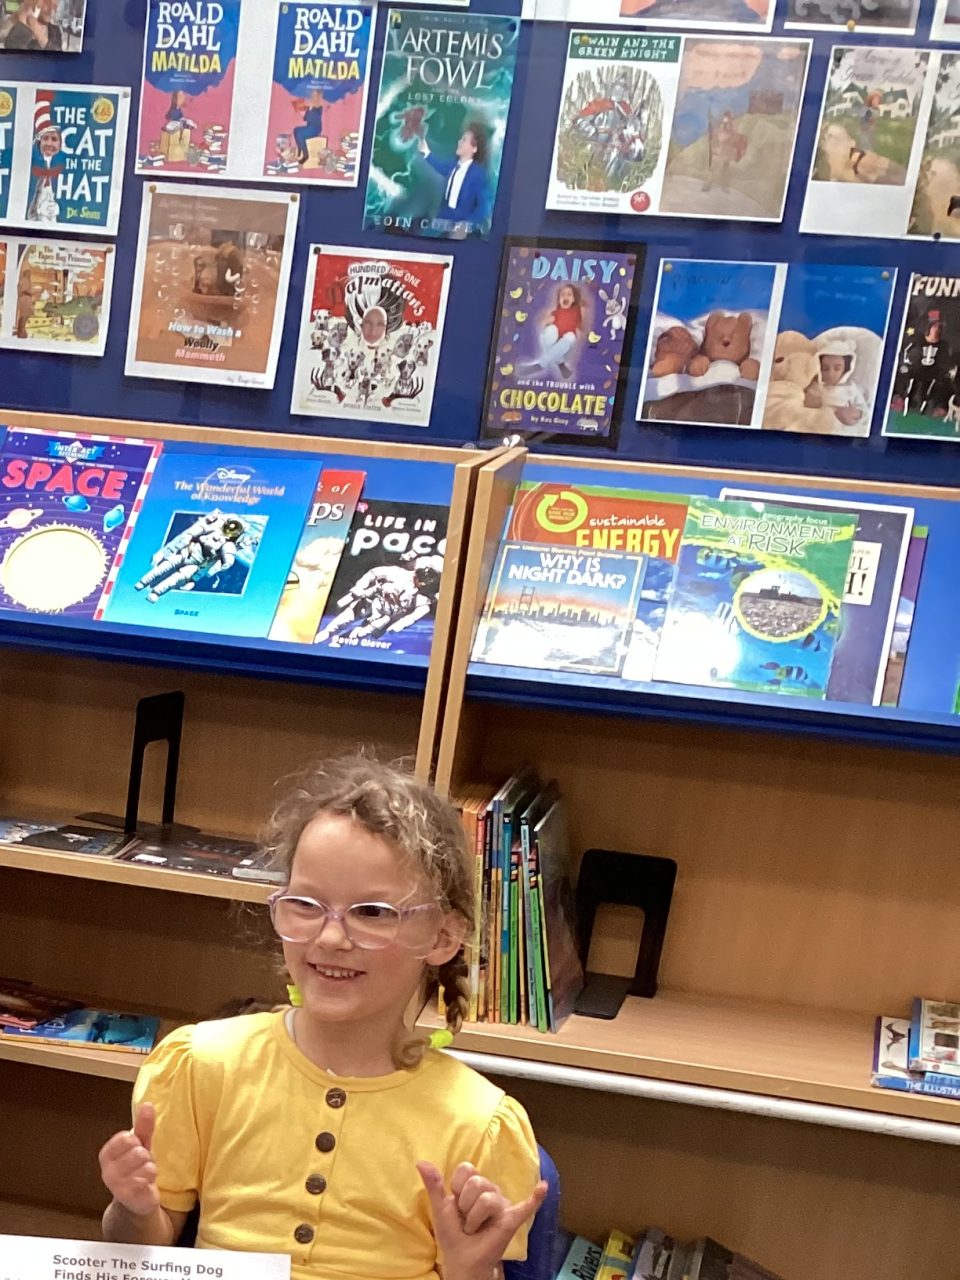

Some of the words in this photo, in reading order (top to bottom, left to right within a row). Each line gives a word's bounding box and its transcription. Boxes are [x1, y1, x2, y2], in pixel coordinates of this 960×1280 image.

[157, 1, 224, 25] ROALD
[295, 7, 363, 31] ROALD
[155, 24, 221, 51] DAHL
[293, 31, 360, 58] DAHL
[401, 27, 505, 59] ARTEMIS
[573, 35, 620, 47] GWAIN
[624, 38, 649, 48] AND
[652, 39, 676, 50] THE
[151, 51, 221, 73] MATILDA
[578, 46, 617, 58] GREEN
[621, 49, 668, 59] KNIGHT
[288, 57, 360, 80] MATILDA
[406, 56, 494, 89] FOWL
[54, 106, 86, 124] THE
[62, 127, 113, 157] CAT
[65, 158, 77, 170] IN
[81, 159, 102, 171] THE
[57, 173, 109, 202] HAT
[66, 206, 78, 219] Dr.
[80, 207, 101, 220] Seuss
[349, 264, 387, 274] HUNDRED
[389, 268, 404, 278] AND
[404, 273, 421, 288] ONE
[532, 255, 618, 283] DAISY
[168, 321, 192, 334] How
[194, 324, 205, 335] to
[207, 324, 234, 337] Wash
[235, 329, 242, 338] a
[183, 337, 220, 352] Woolly
[175, 348, 226, 362] Mammoth
[546, 381, 577, 390] TROUBLE
[579, 382, 595, 390] with
[500, 388, 607, 416] CHOCOLATE
[530, 415, 539, 423] by
[2, 459, 128, 500] SPACE
[174, 480, 194, 491] The
[196, 482, 251, 496] Wonderful
[253, 486, 286, 497] World
[331, 482, 352, 495] of
[191, 493, 203, 501] of
[203, 493, 261, 506] Knowledge
[364, 515, 406, 530] LIFE
[414, 519, 437, 531] IN
[589, 514, 667, 528] sustainable
[701, 514, 840, 541] ENVIRONMENT
[762, 513, 804, 525] geography
[806, 514, 829, 525] focus
[576, 528, 680, 559] ENERGY
[727, 536, 747, 548] AT
[748, 533, 806, 558] RISK
[540, 552, 582, 571] WHY
[585, 557, 601, 571] IS
[508, 565, 567, 585] NIGHT
[567, 570, 627, 590] DARK?
[174, 608, 200, 617] SPACE
[905, 1080, 922, 1091] THE
[53, 1254, 107, 1268] Scooter
[111, 1258, 137, 1270] The
[141, 1260, 191, 1276] Surfing
[196, 1264, 223, 1278] Dog
[54, 1269, 92, 1280] Finds
